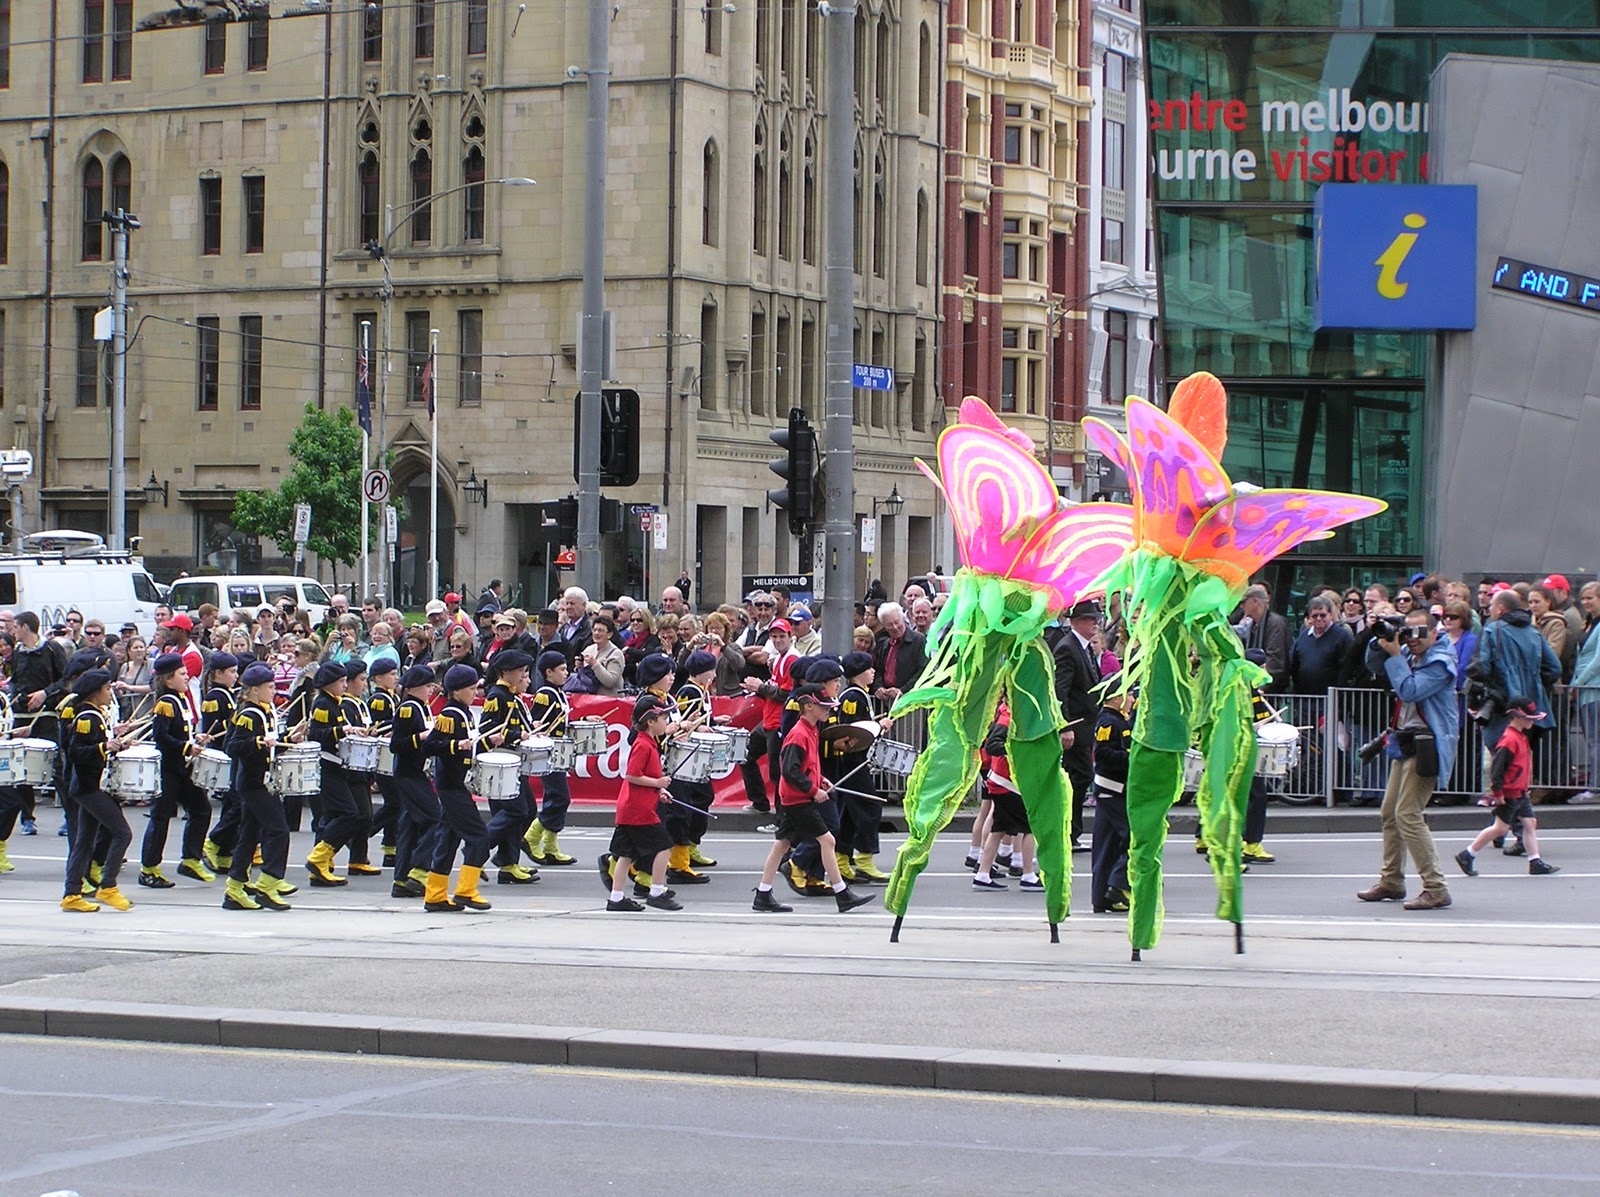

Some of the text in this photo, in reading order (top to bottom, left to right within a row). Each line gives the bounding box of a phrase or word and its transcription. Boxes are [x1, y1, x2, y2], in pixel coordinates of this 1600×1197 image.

[1152, 148, 1257, 180] urne
[1271, 136, 1407, 182] visitor
[1520, 269, 1569, 298] AND
[752, 577, 799, 586] MELBOURNE
